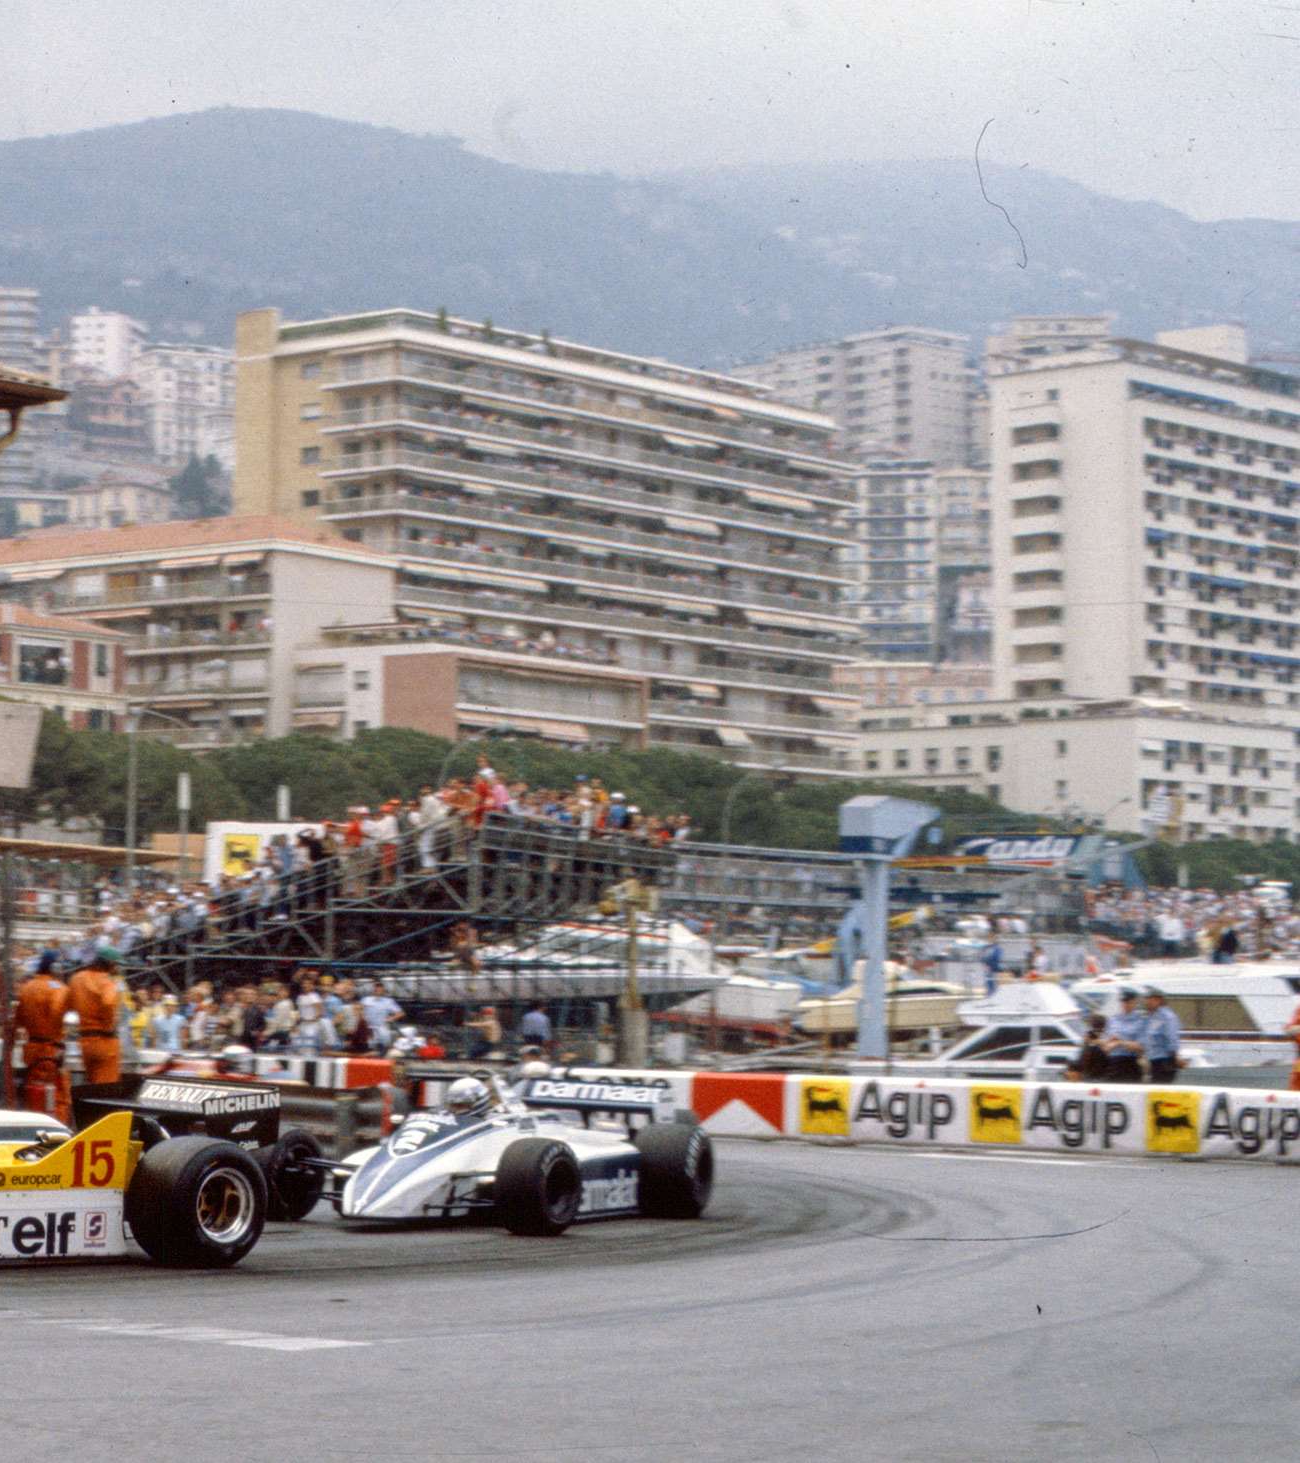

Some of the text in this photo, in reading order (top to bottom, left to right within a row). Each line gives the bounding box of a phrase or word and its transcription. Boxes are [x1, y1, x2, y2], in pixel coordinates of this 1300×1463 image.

[204, 1092, 281, 1116] MICHELIN
[531, 1080, 665, 1104] parmalat
[855, 1081, 953, 1140] Agip
[1028, 1087, 1128, 1148] Agip
[1204, 1093, 1300, 1156] Agip
[11, 1172, 62, 1188] europcar
[70, 1140, 115, 1188] 15
[12, 1211, 76, 1255] elf
